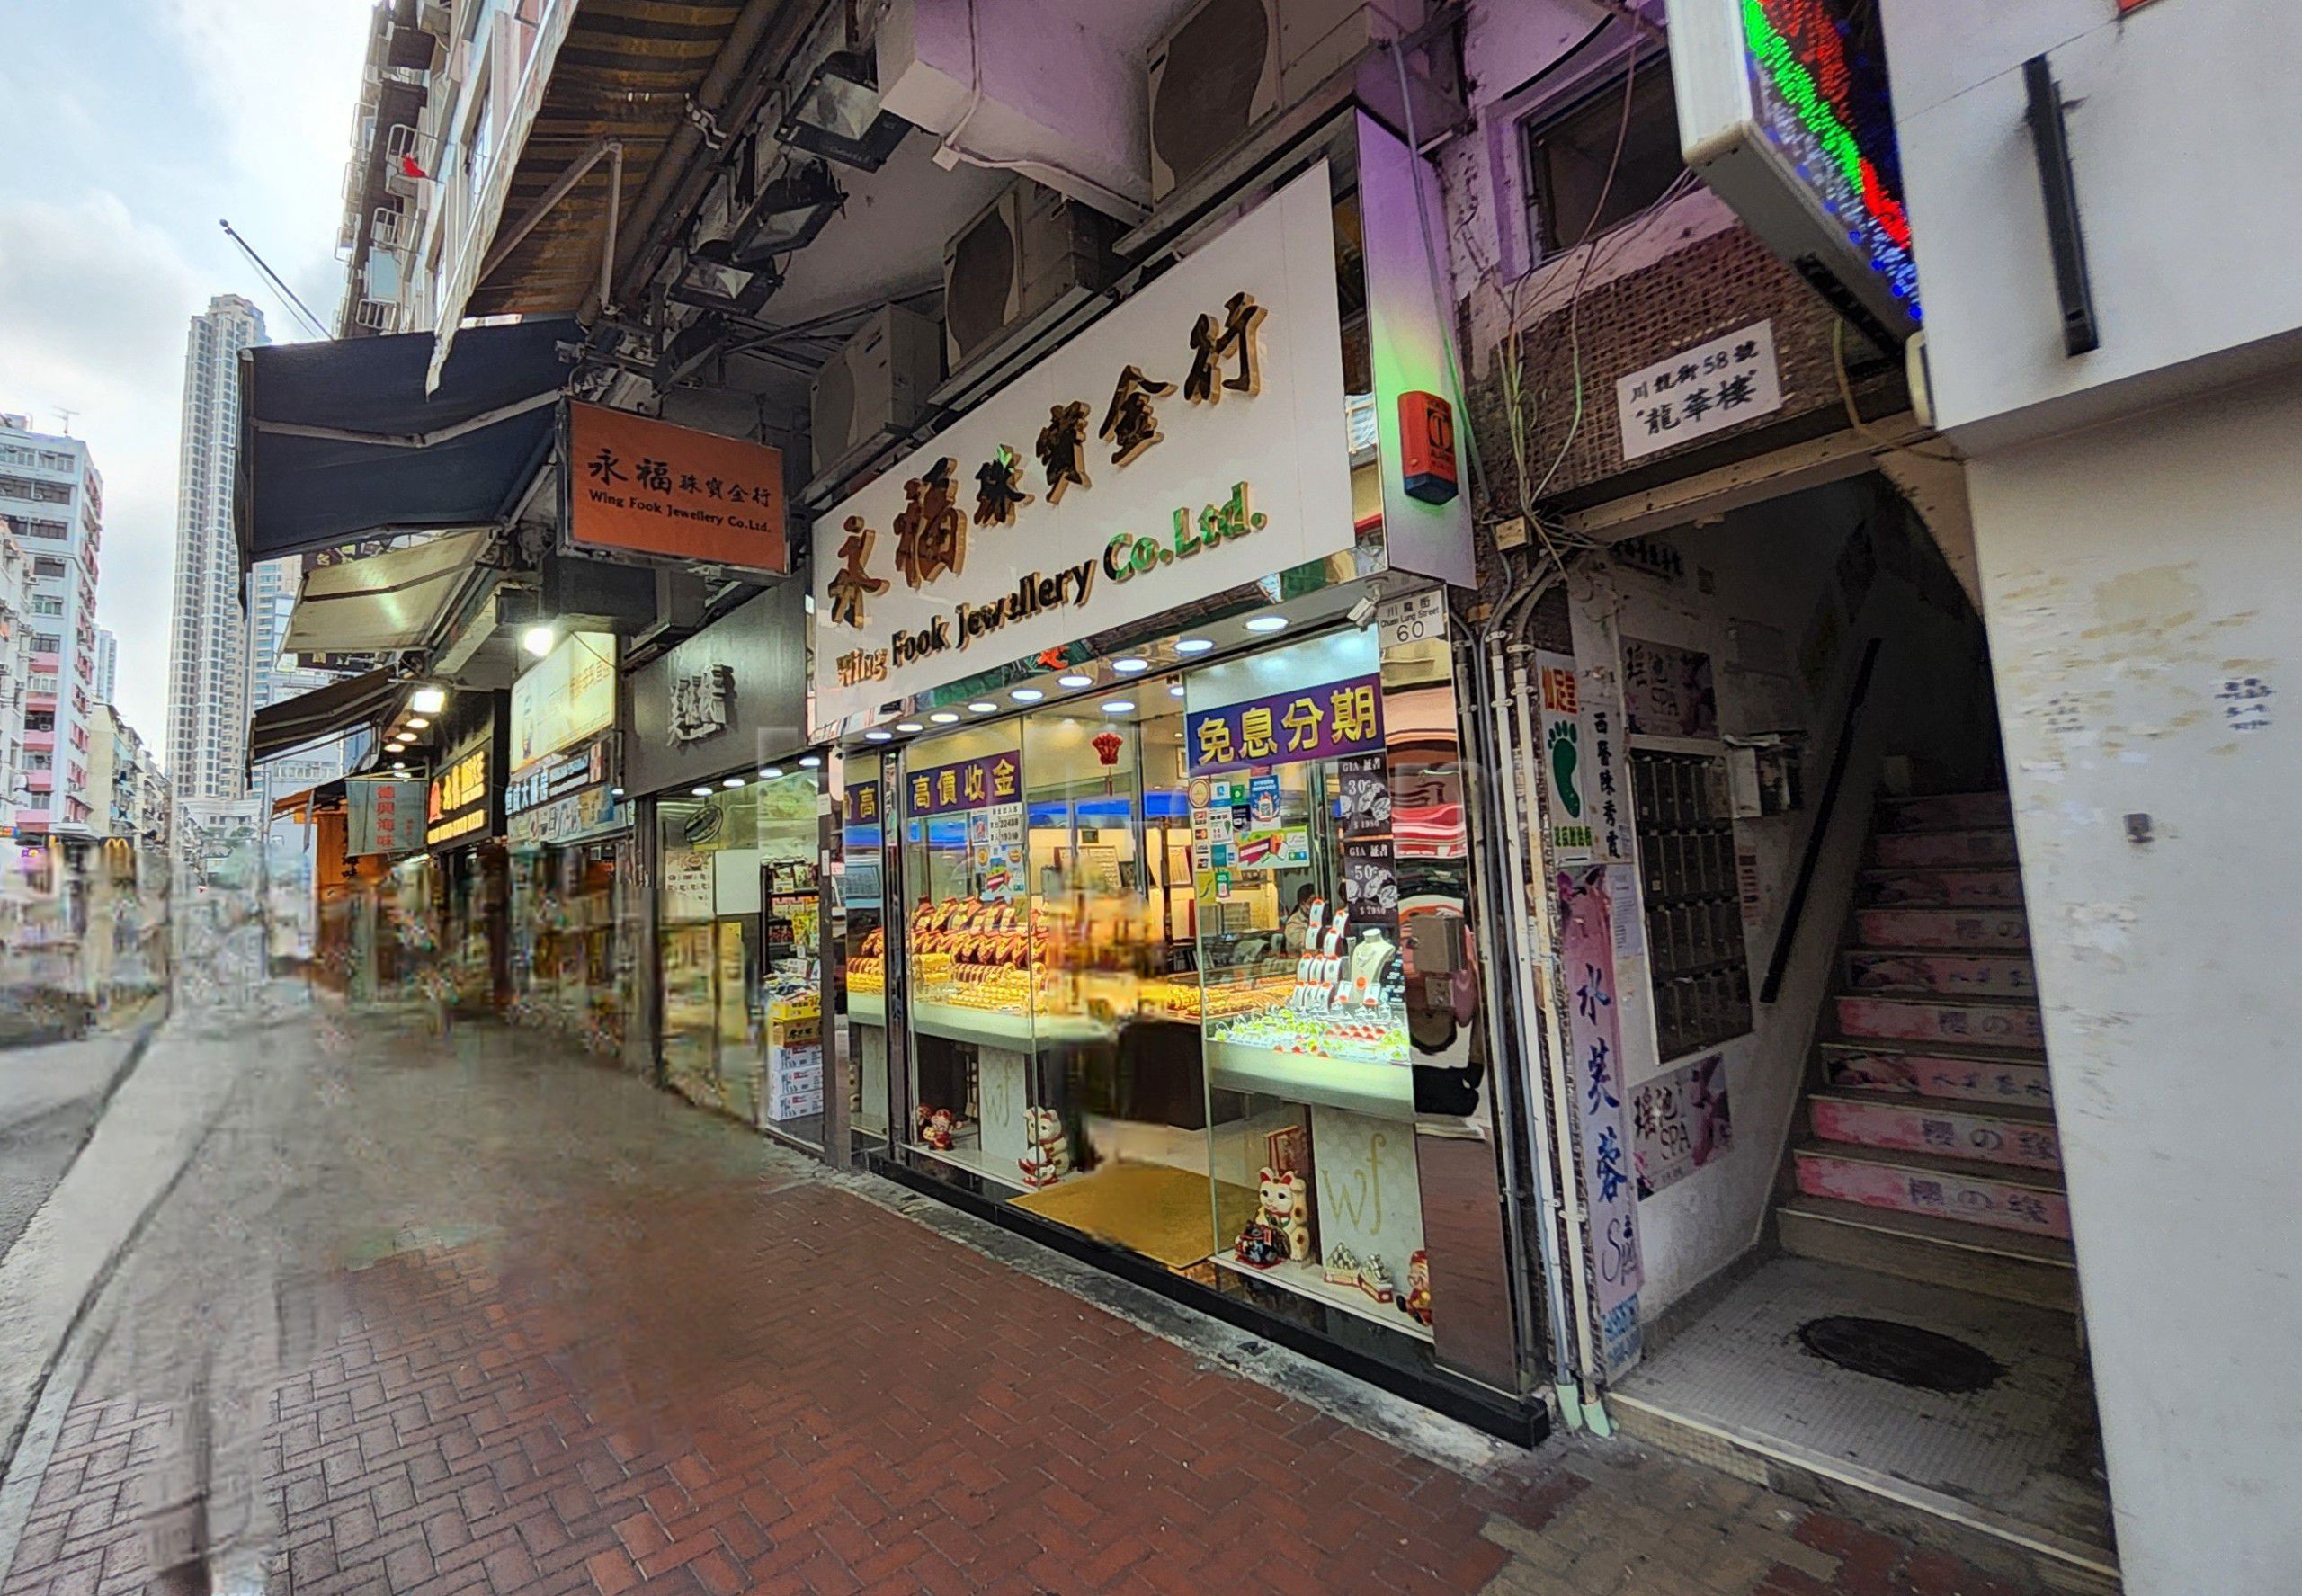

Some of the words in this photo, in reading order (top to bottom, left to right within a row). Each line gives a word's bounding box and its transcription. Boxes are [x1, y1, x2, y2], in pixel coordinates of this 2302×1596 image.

[587, 448, 772, 508] 永福珠寶金行
[828, 292, 1269, 629] 永福珠寶金行
[588, 488, 624, 508] Wing
[629, 496, 663, 514] Fook
[667, 504, 724, 525] Jewellery
[836, 648, 888, 687] Wing
[892, 614, 950, 667] Fook
[955, 557, 1097, 652] Jewellery
[1396, 620, 1424, 642] 60
[1400, 612, 1416, 623] Lung
[1418, 606, 1439, 618] Street
[1198, 684, 1377, 765] 免息分期
[912, 757, 1016, 811] 高價收金
[1343, 761, 1359, 772] GIA
[1349, 847, 1366, 857] GIA
